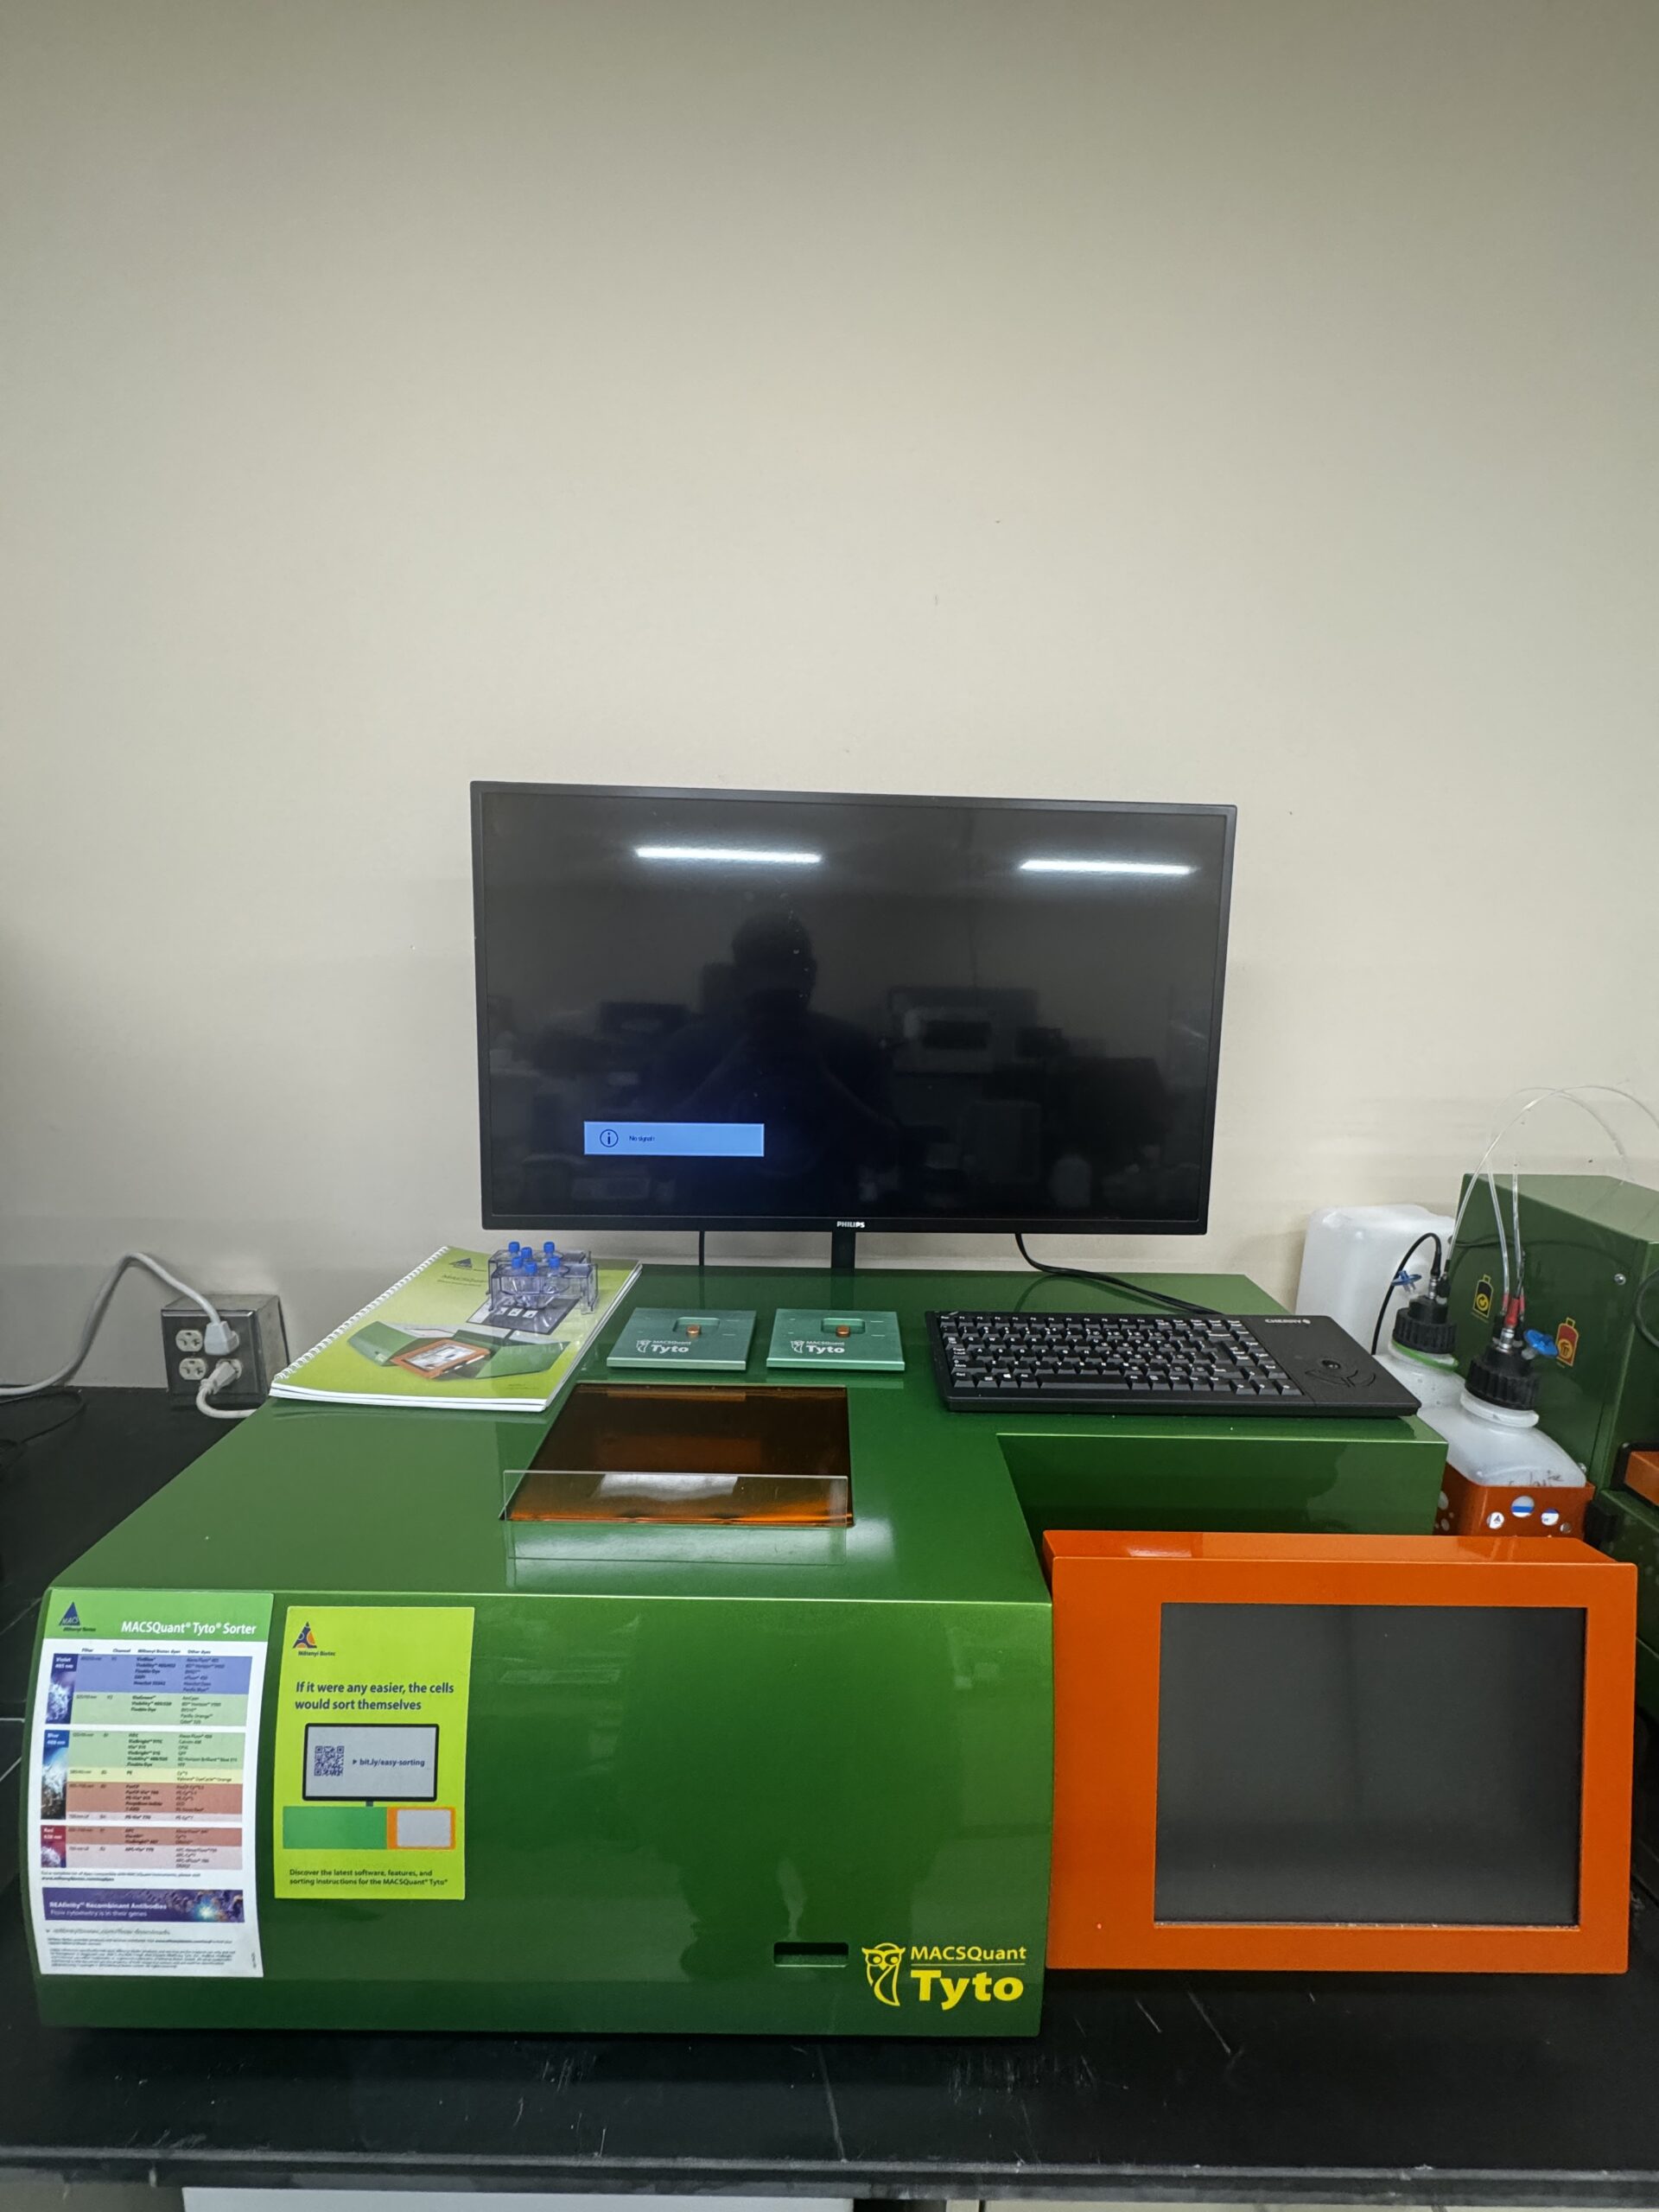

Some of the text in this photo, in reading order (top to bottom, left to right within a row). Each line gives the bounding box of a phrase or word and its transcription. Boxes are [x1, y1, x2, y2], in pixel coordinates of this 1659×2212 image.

[652, 1345, 689, 1354] Tyto
[223, 1623, 257, 1634] Sorter
[296, 1681, 454, 1695] If it were any easier, the cells
[295, 1699, 422, 1710] would sort themselves
[359, 1758, 425, 1767] bit.ly/easy-sorting
[911, 1947, 1027, 1961] MACSQuant
[910, 1969, 1024, 2011] Tyto
